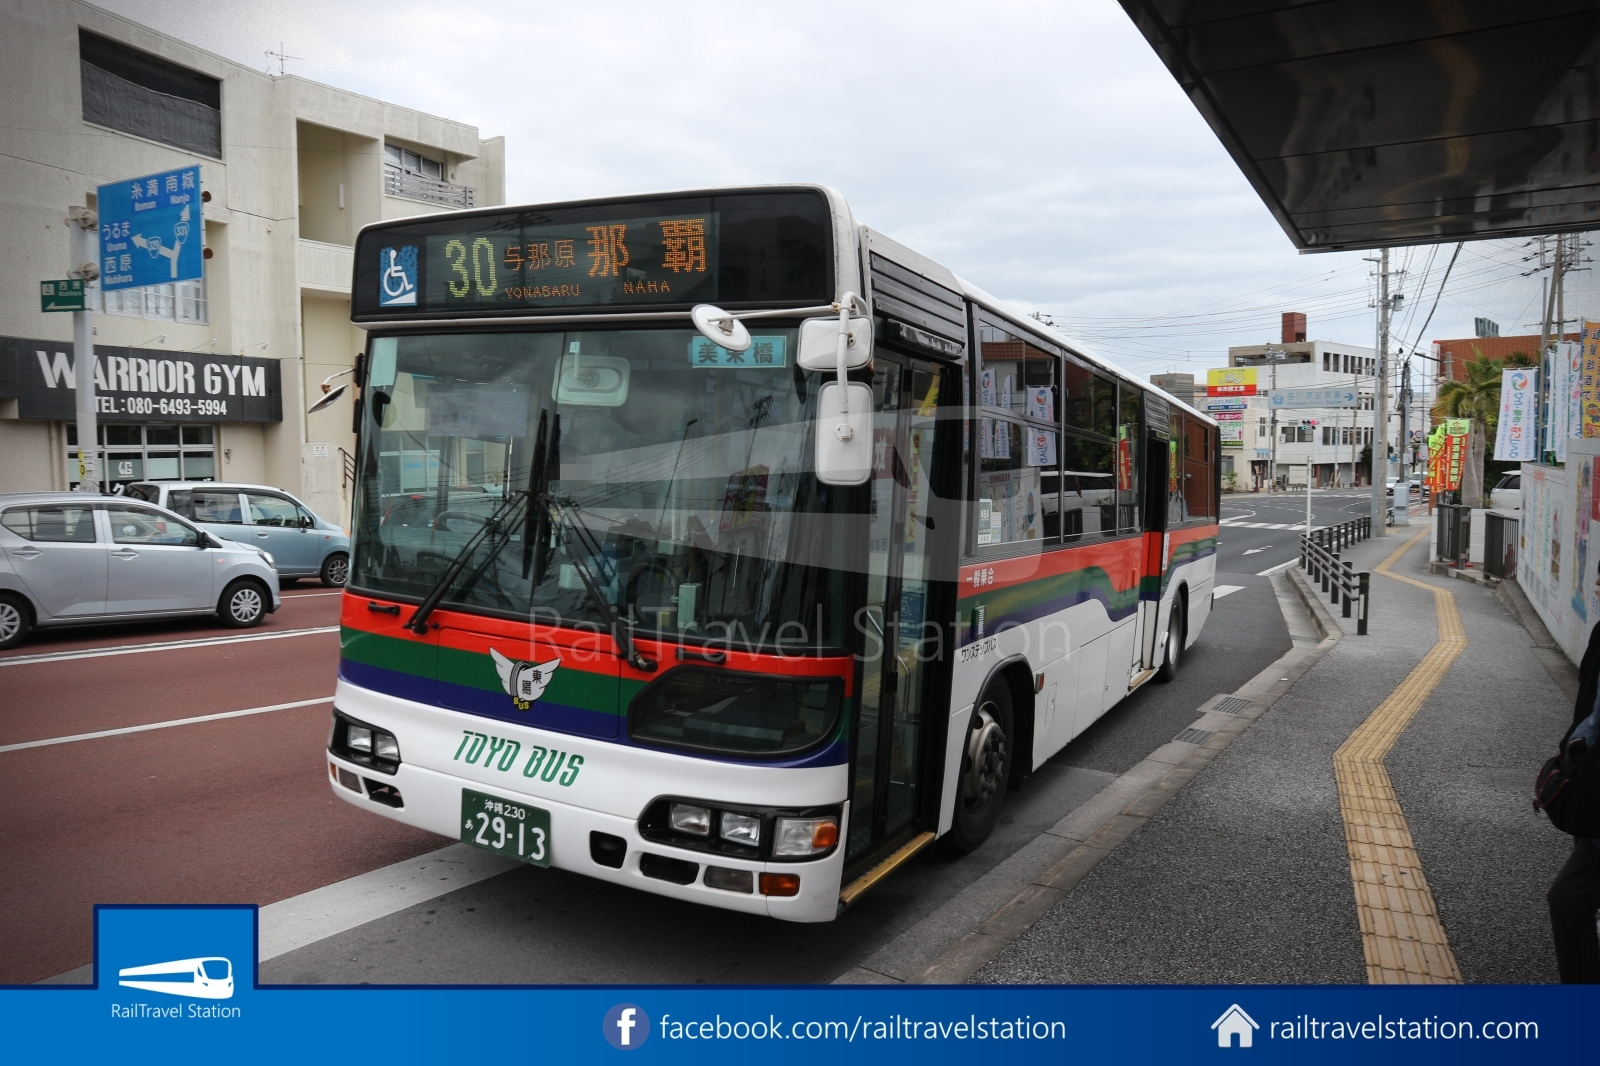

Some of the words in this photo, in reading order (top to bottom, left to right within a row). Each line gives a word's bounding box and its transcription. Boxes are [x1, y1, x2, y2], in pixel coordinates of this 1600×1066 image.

[131, 179, 159, 200] 糸満
[165, 171, 195, 194] 南城
[170, 195, 190, 205] Nanjo
[102, 221, 131, 241] うるま
[176, 225, 188, 237] 331
[106, 242, 127, 253] Uruma
[504, 239, 576, 271] 与那原
[586, 217, 707, 279] 那覇
[104, 254, 132, 275] 西原
[444, 237, 498, 299] 30
[104, 274, 133, 286] Nishihara
[623, 280, 671, 295] NAHA
[504, 283, 580, 300] YONABARU
[36, 351, 196, 394] WARRIOR
[203, 361, 266, 397] GYM
[966, 567, 995, 588] 一般乗合
[513, 697, 530, 711] BUS
[453, 730, 522, 773] TOYO
[523, 745, 585, 788] BUS
[465, 819, 474, 831] あ
[474, 812, 546, 862] 29-13
